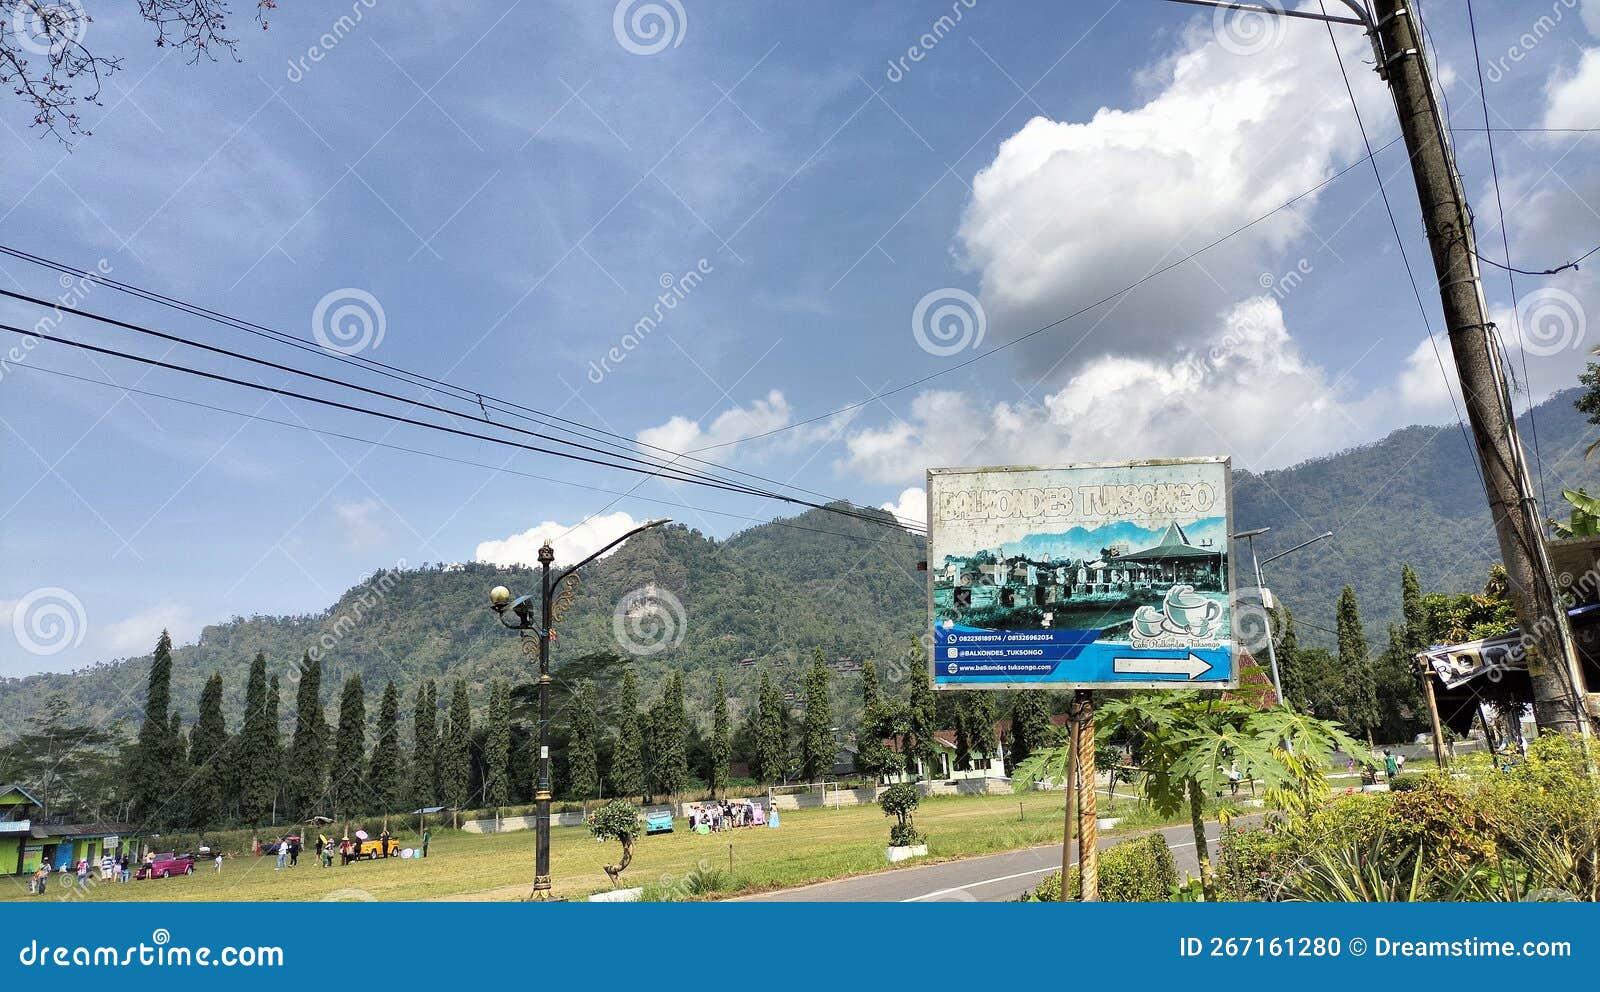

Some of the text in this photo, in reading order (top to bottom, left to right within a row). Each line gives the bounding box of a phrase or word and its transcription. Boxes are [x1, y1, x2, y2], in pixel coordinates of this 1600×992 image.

[939, 482, 1215, 521] BALKONDES TUKSONGO
[1186, 639, 1220, 650] Tuksongo
[959, 649, 1043, 657] @BALKONDES_TUKSONGO
